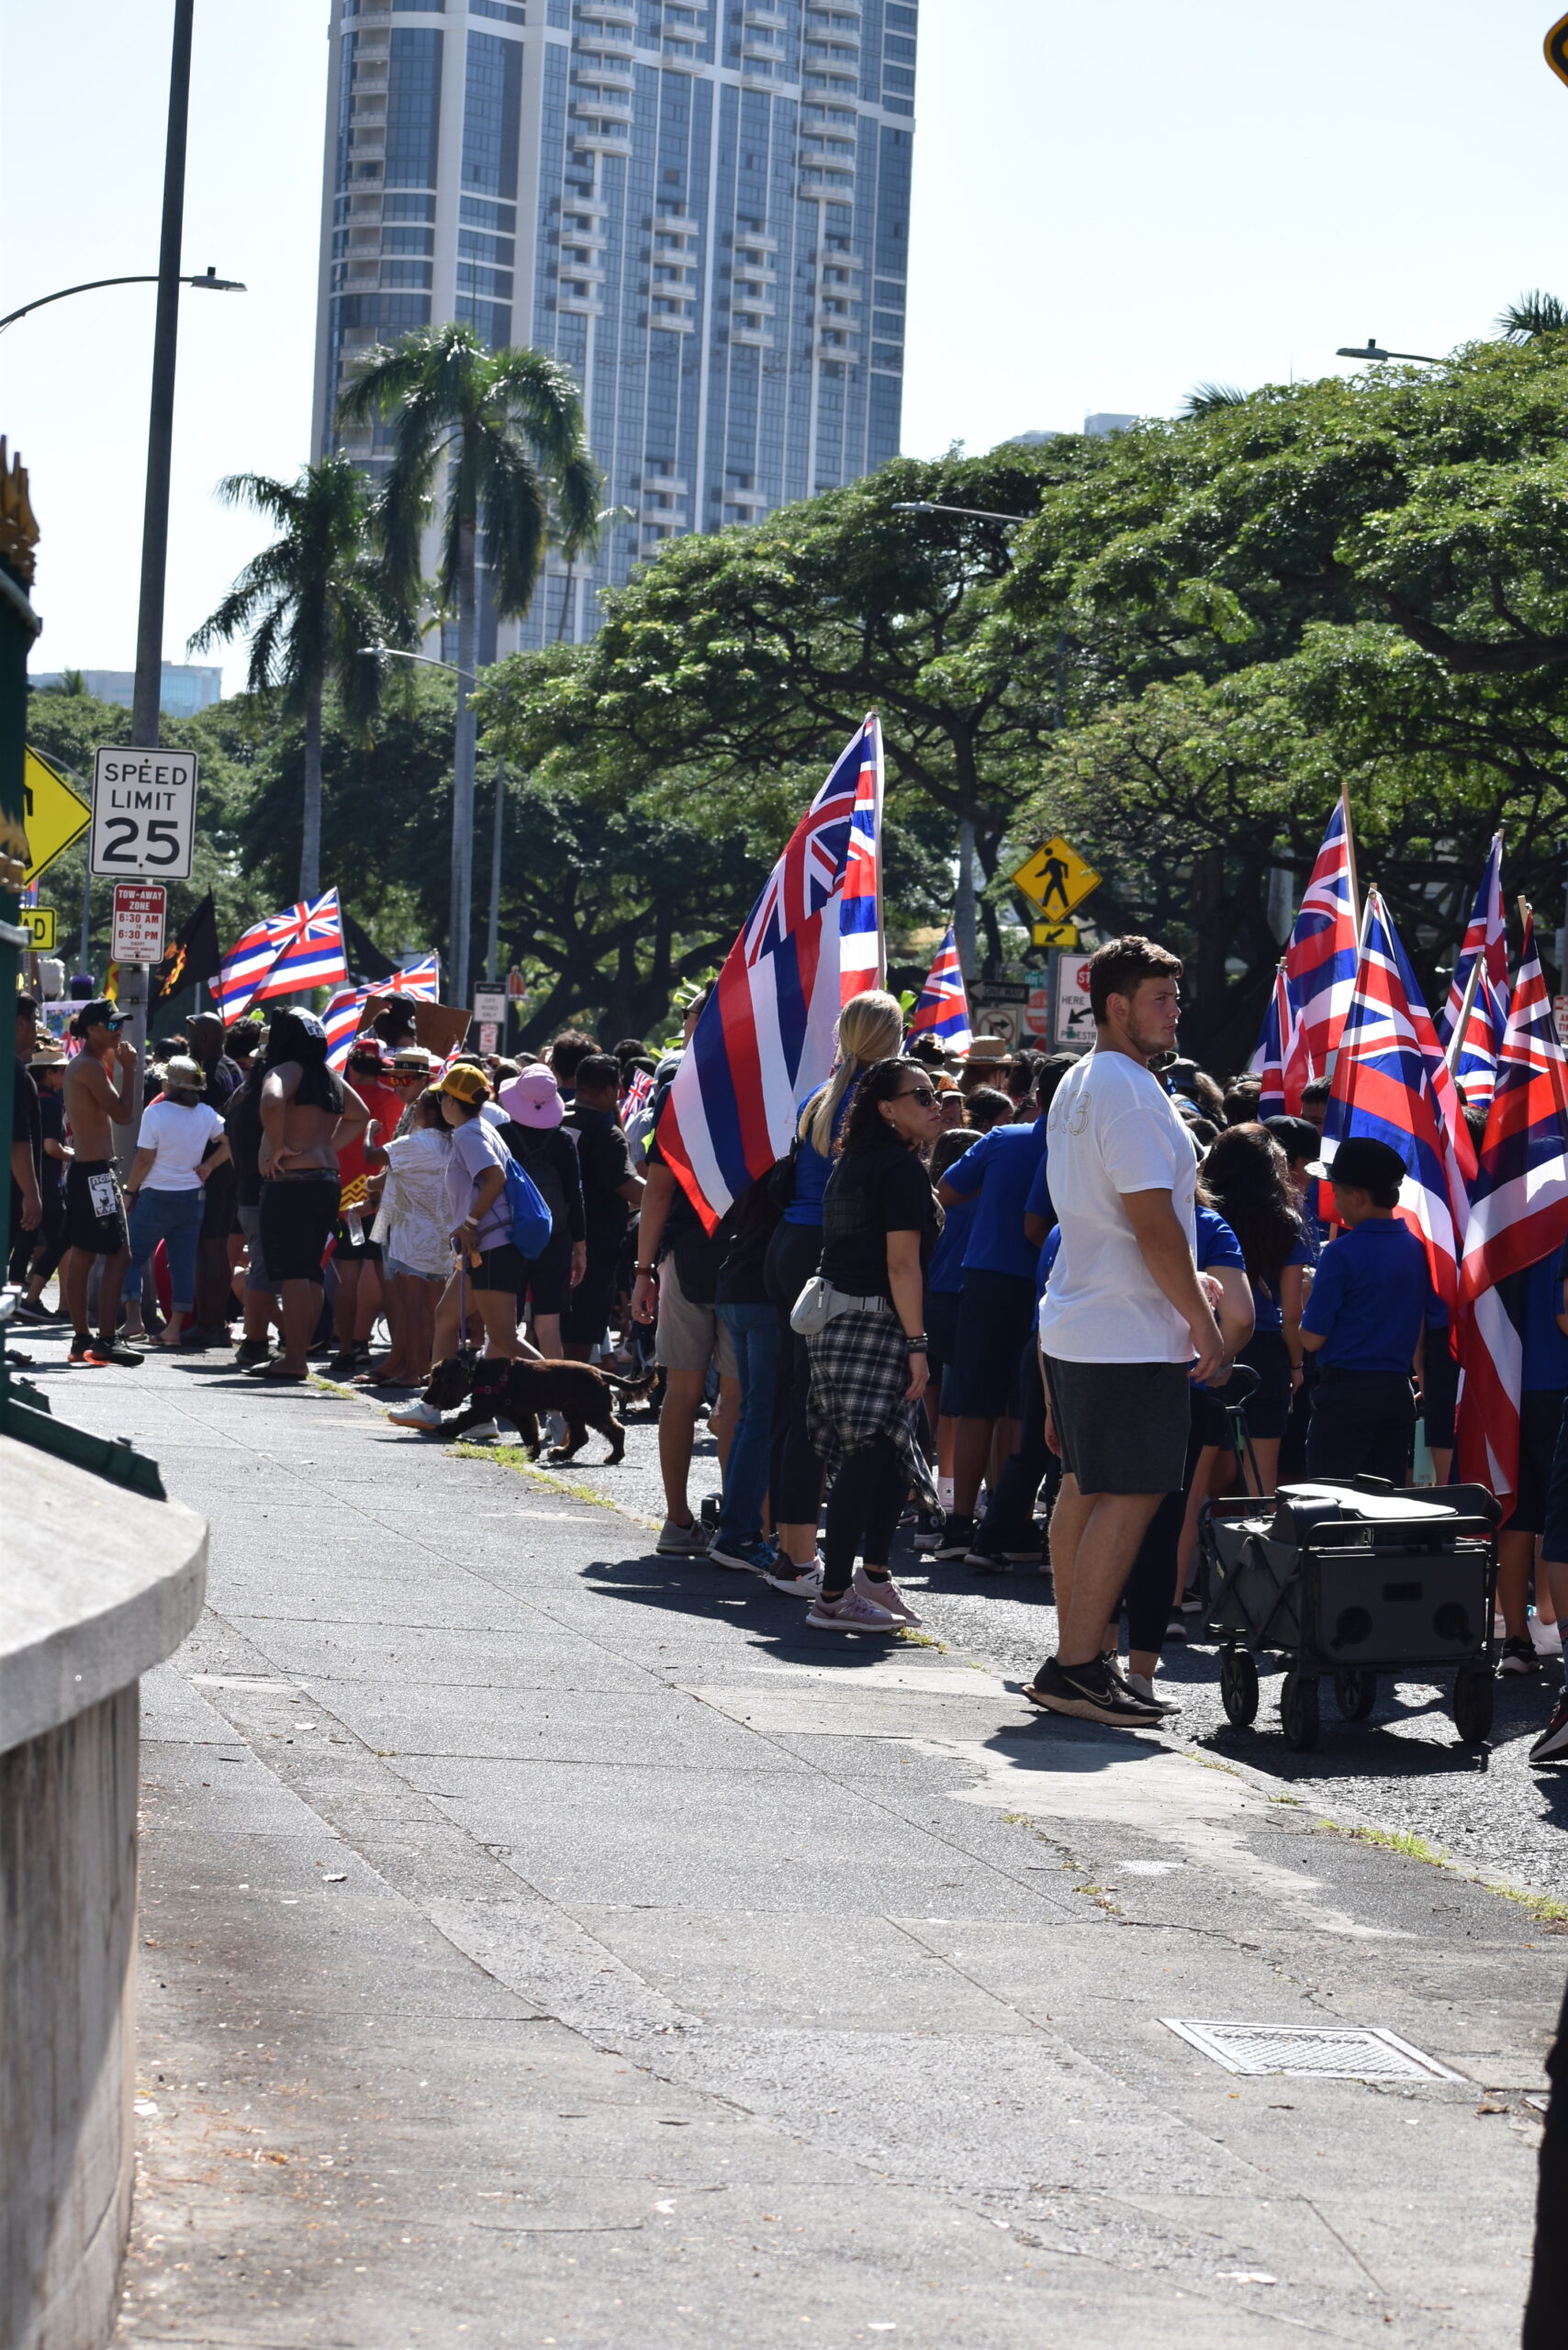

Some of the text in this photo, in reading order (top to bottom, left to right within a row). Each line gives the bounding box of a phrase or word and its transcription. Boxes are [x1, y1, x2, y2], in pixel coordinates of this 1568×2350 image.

[104, 763, 187, 786] SPEED
[111, 789, 176, 811] LIMIT
[102, 817, 180, 866] 25
[118, 890, 162, 901] TOW-AWAY
[129, 901, 151, 911] ZONE
[118, 912, 159, 923] 6:30 AM
[118, 930, 159, 940] 6:30 PM
[1061, 996, 1085, 1005] HERE
